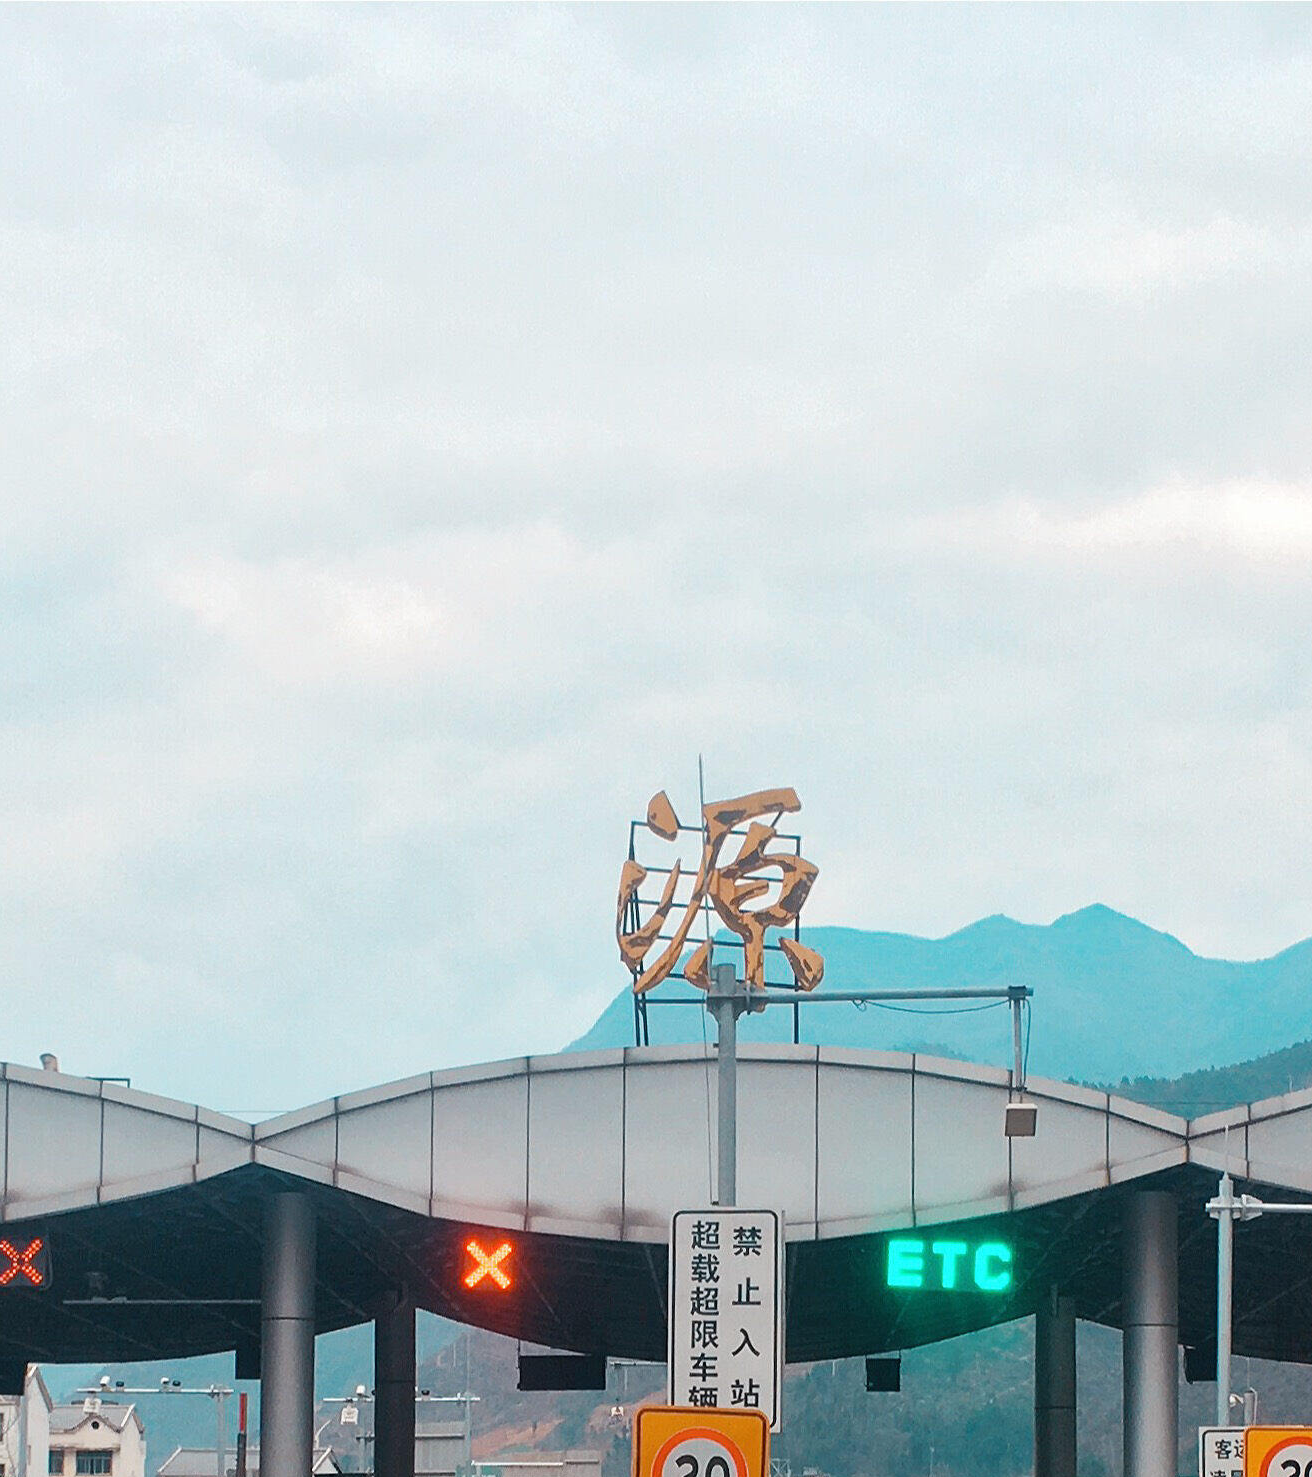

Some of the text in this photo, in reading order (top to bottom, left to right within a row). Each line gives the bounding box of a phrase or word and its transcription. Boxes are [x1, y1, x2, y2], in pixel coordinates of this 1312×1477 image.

[619, 788, 824, 1003] 源
[730, 1226, 763, 1408] 禁止入站
[887, 1238, 1013, 1291] ETC
